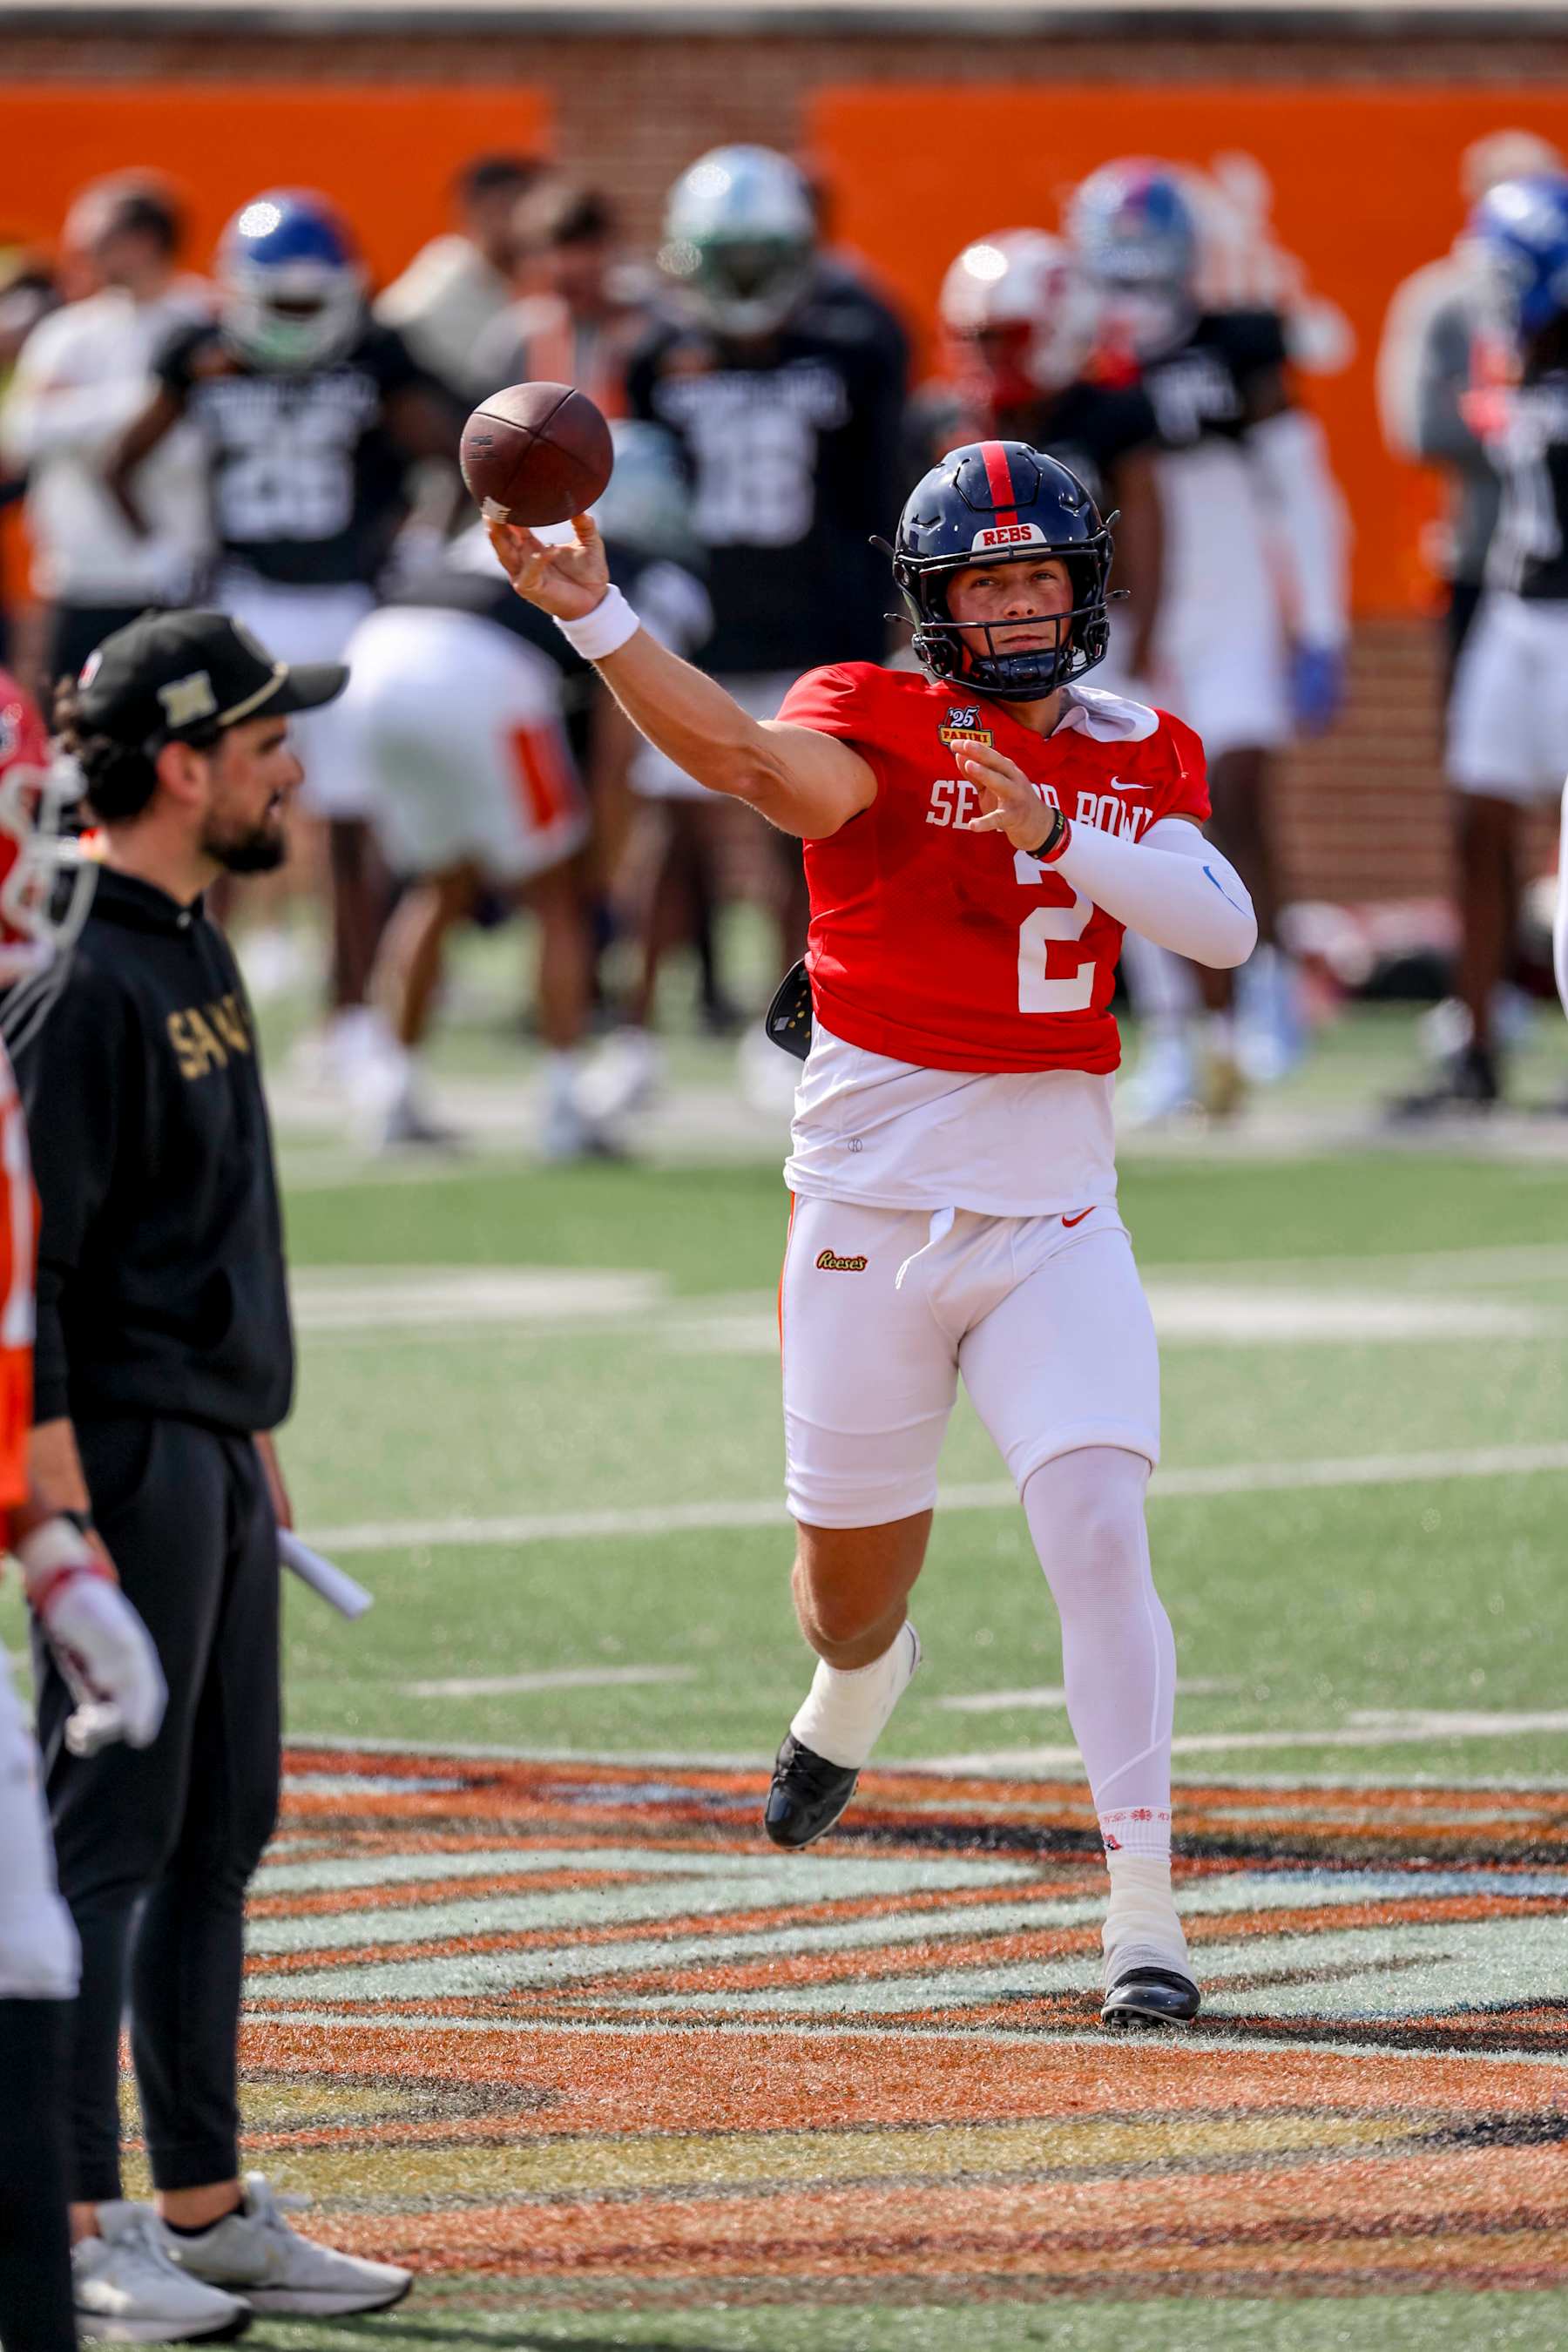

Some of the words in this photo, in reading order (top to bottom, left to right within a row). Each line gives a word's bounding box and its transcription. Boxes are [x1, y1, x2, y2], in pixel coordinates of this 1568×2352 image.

[983, 525, 1032, 546] REBS
[950, 707, 977, 727] '25
[943, 730, 990, 743] PANINI
[1013, 848, 1097, 1014] 2
[817, 1250, 868, 1271] Reese's
